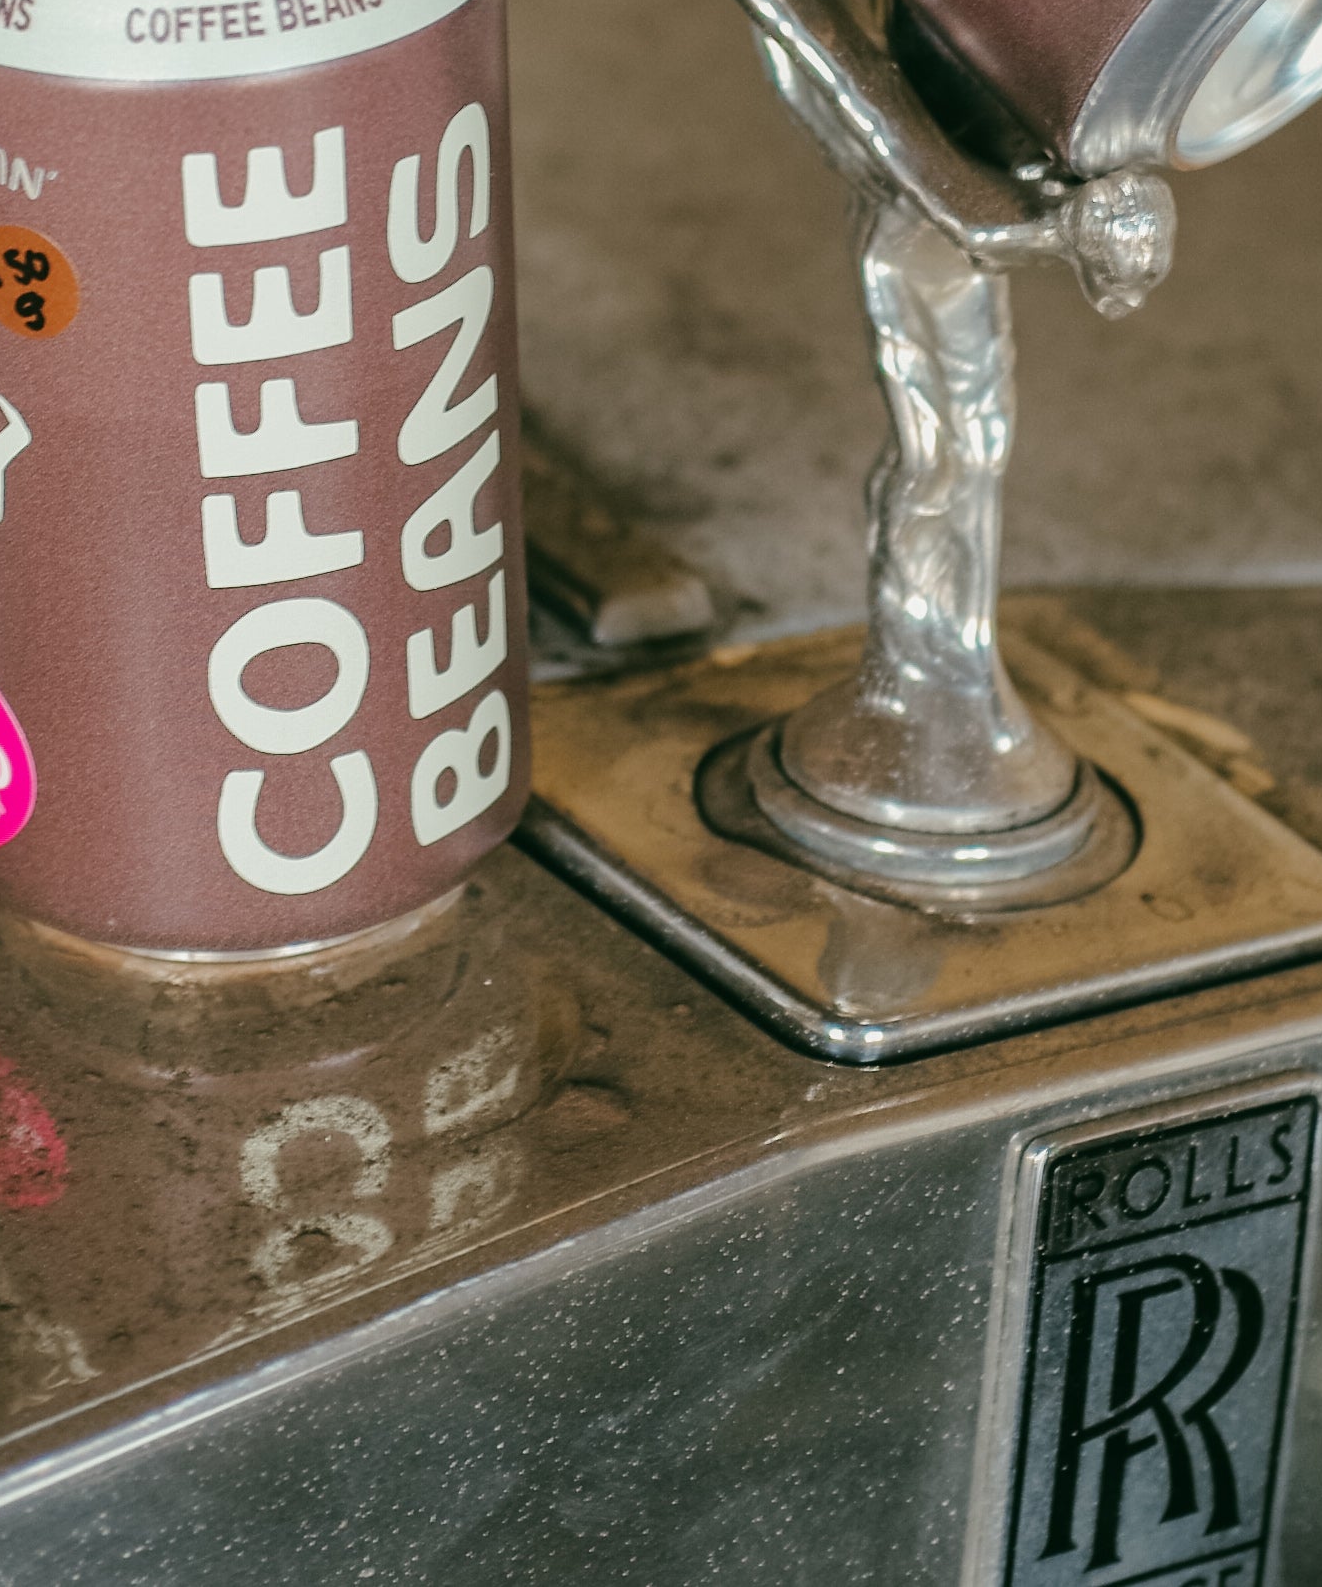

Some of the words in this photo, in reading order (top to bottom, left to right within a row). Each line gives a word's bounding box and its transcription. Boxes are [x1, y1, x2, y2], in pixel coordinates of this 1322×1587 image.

[126, 0, 266, 44] COFFEE
[181, 124, 378, 896] COFFEE
[386, 100, 512, 848] BEANS
[1065, 1123, 1296, 1239] ROLLS
